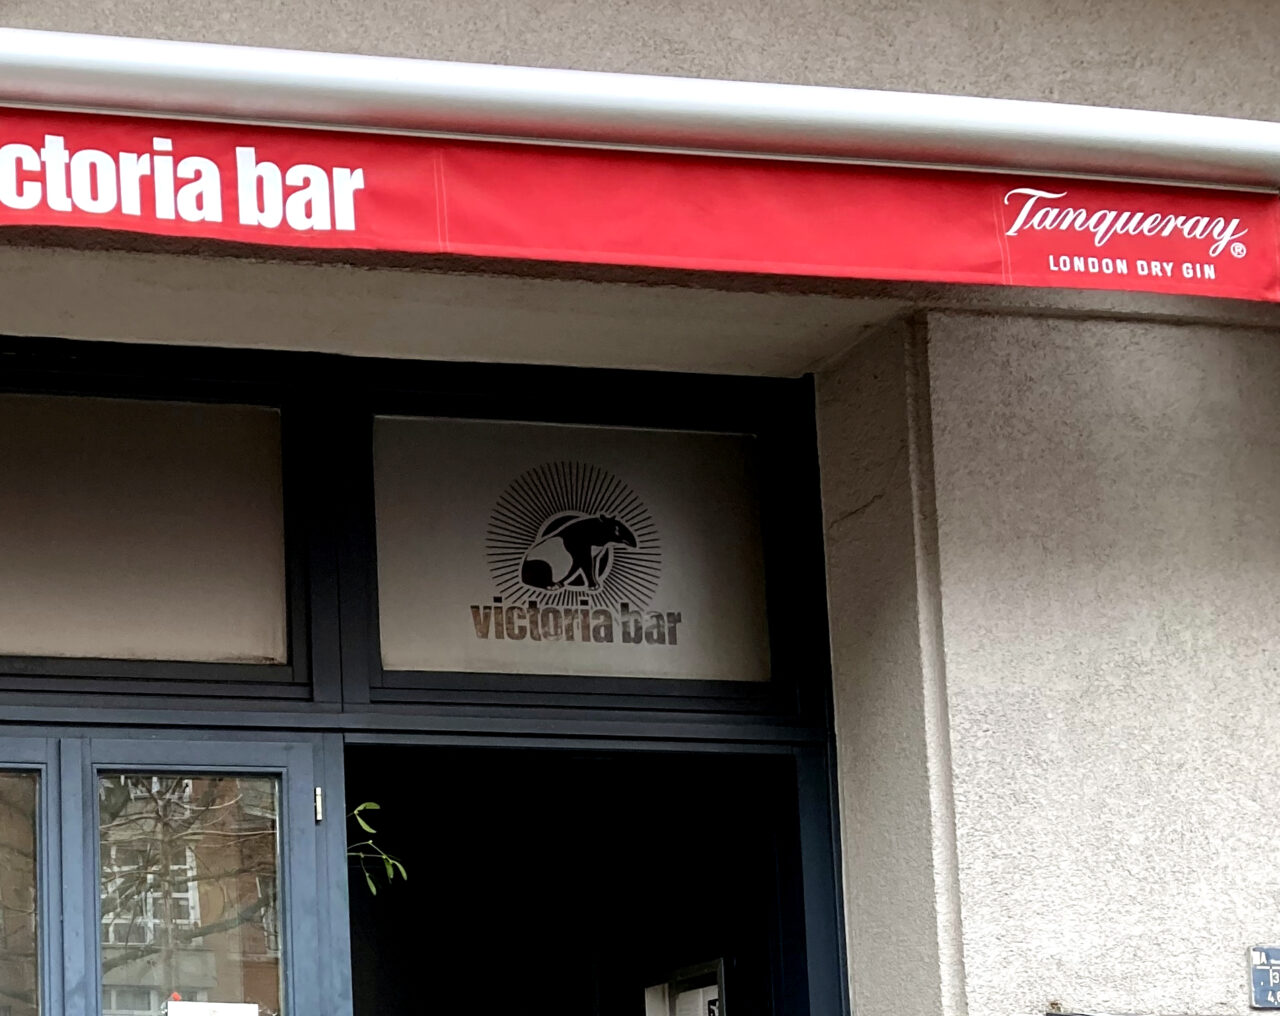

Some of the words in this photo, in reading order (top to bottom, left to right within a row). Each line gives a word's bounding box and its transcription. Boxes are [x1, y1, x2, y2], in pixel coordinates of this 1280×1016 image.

[235, 146, 365, 231] bar
[1004, 187, 1249, 257] Tanqueray
[1048, 254, 1128, 275] LONDON
[1136, 259, 1174, 277] DRY
[1181, 262, 1216, 280] GIN
[470, 596, 614, 643] victoria
[620, 602, 682, 645] bar
